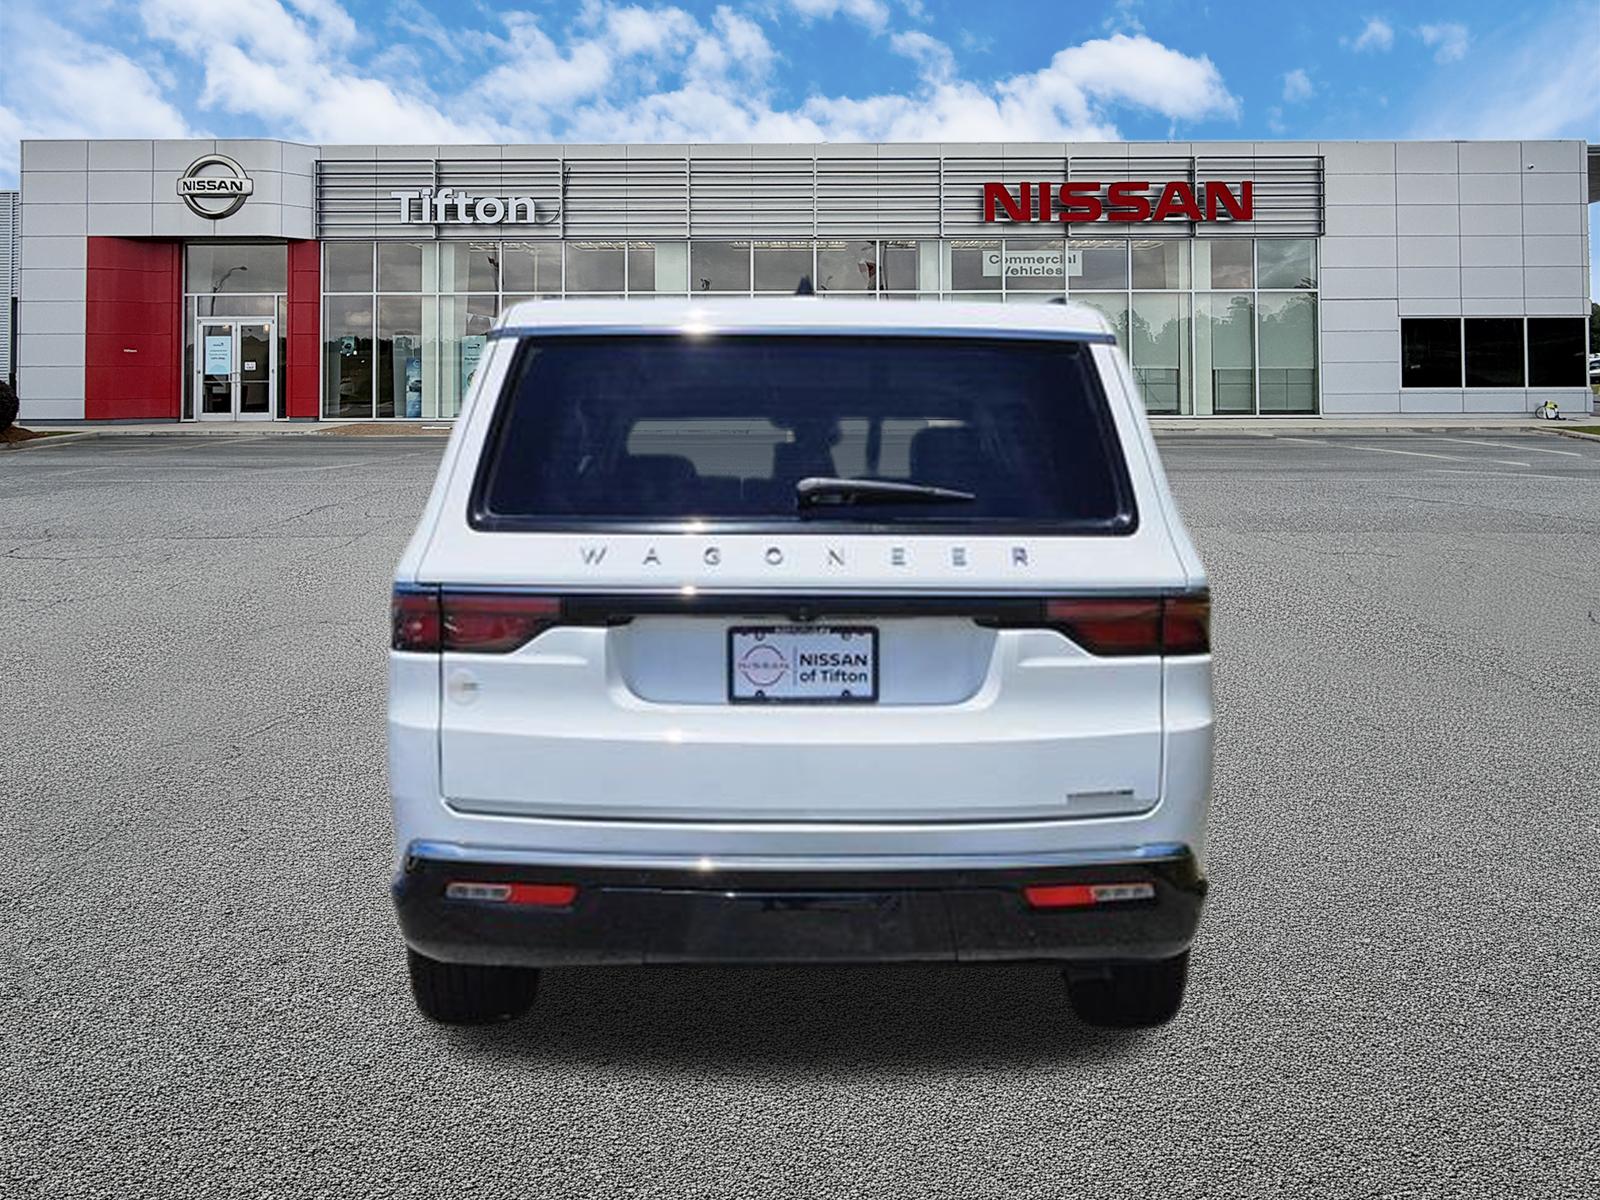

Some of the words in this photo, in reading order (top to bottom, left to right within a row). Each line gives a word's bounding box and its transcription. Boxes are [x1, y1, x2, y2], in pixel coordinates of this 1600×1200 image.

[182, 180, 243, 191] NISSAN
[391, 187, 536, 224] Tifton
[983, 181, 1253, 222] NISSAN
[580, 546, 1028, 566] WAGONEER
[800, 653, 868, 667] NISSAN
[799, 669, 816, 682] of
[822, 669, 868, 683] Tifton
